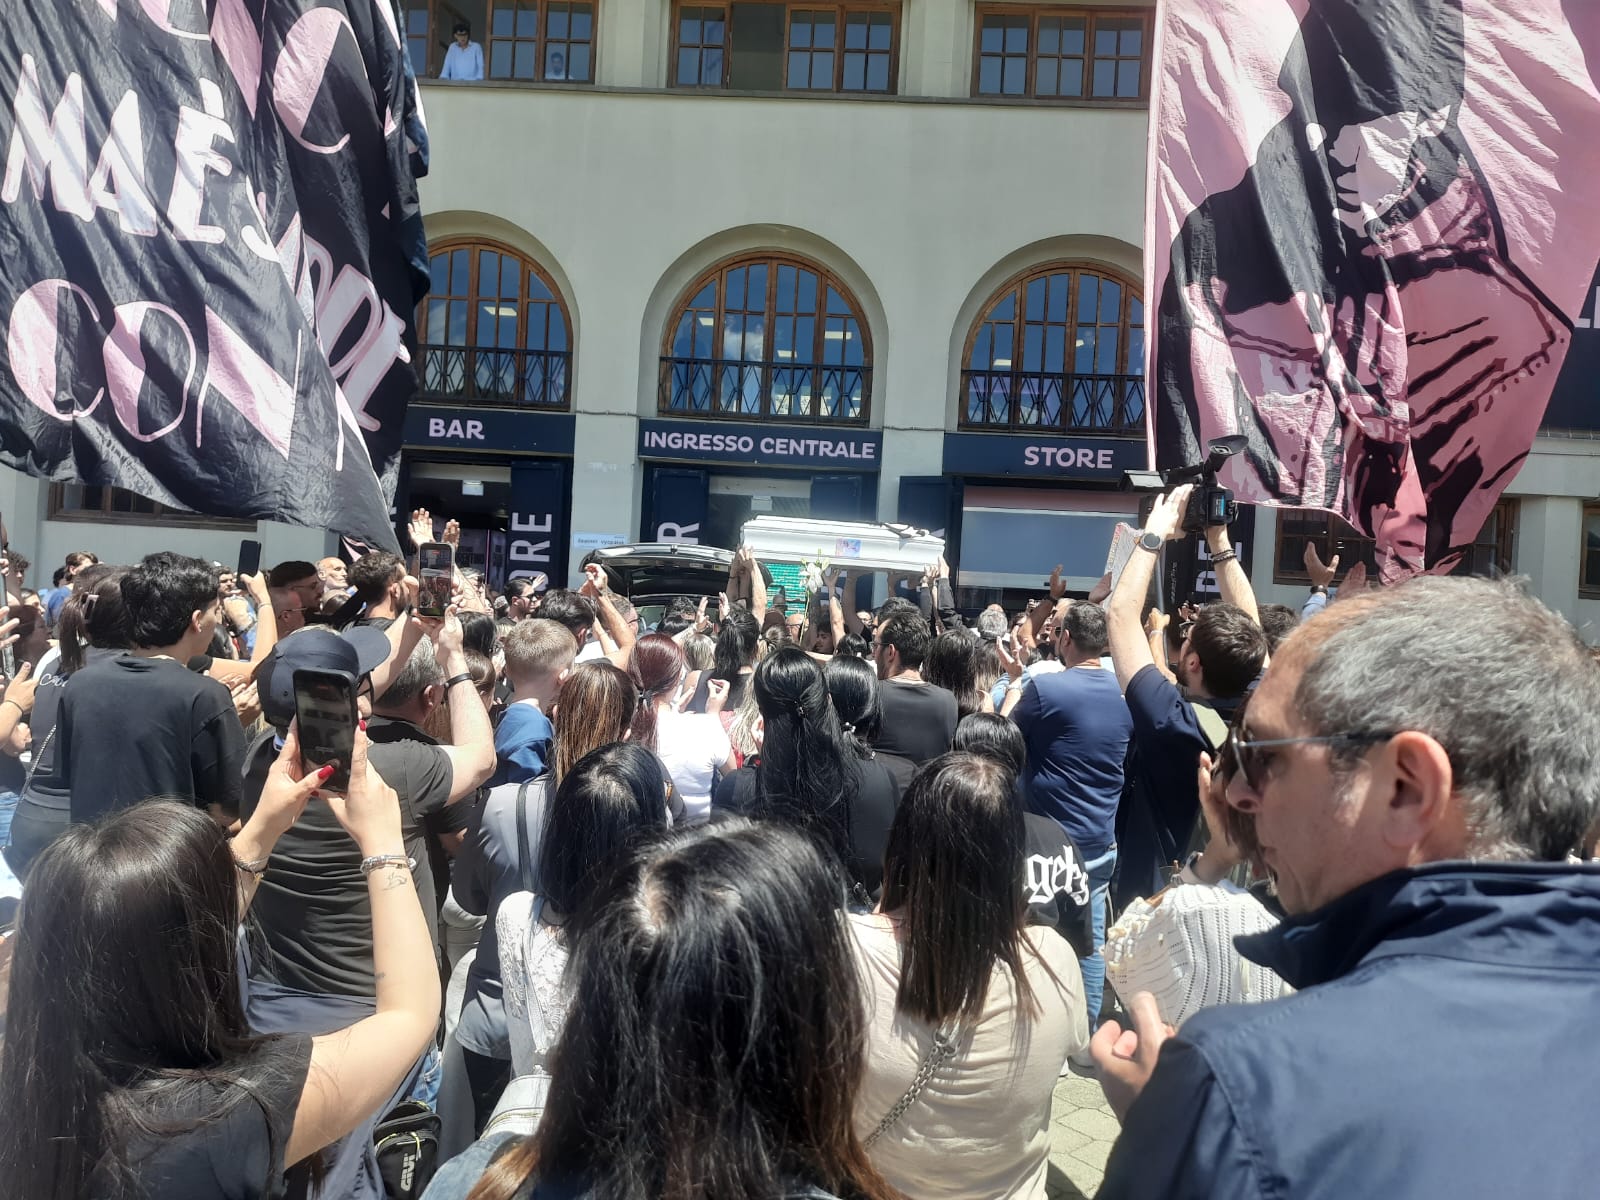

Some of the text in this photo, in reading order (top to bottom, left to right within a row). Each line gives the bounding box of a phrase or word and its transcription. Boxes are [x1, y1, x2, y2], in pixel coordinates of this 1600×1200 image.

[8, 278, 303, 460] CON
[428, 417, 485, 440] BAR
[644, 431, 875, 459] INGRESSO CENTRALE
[1024, 446, 1114, 469] STORE
